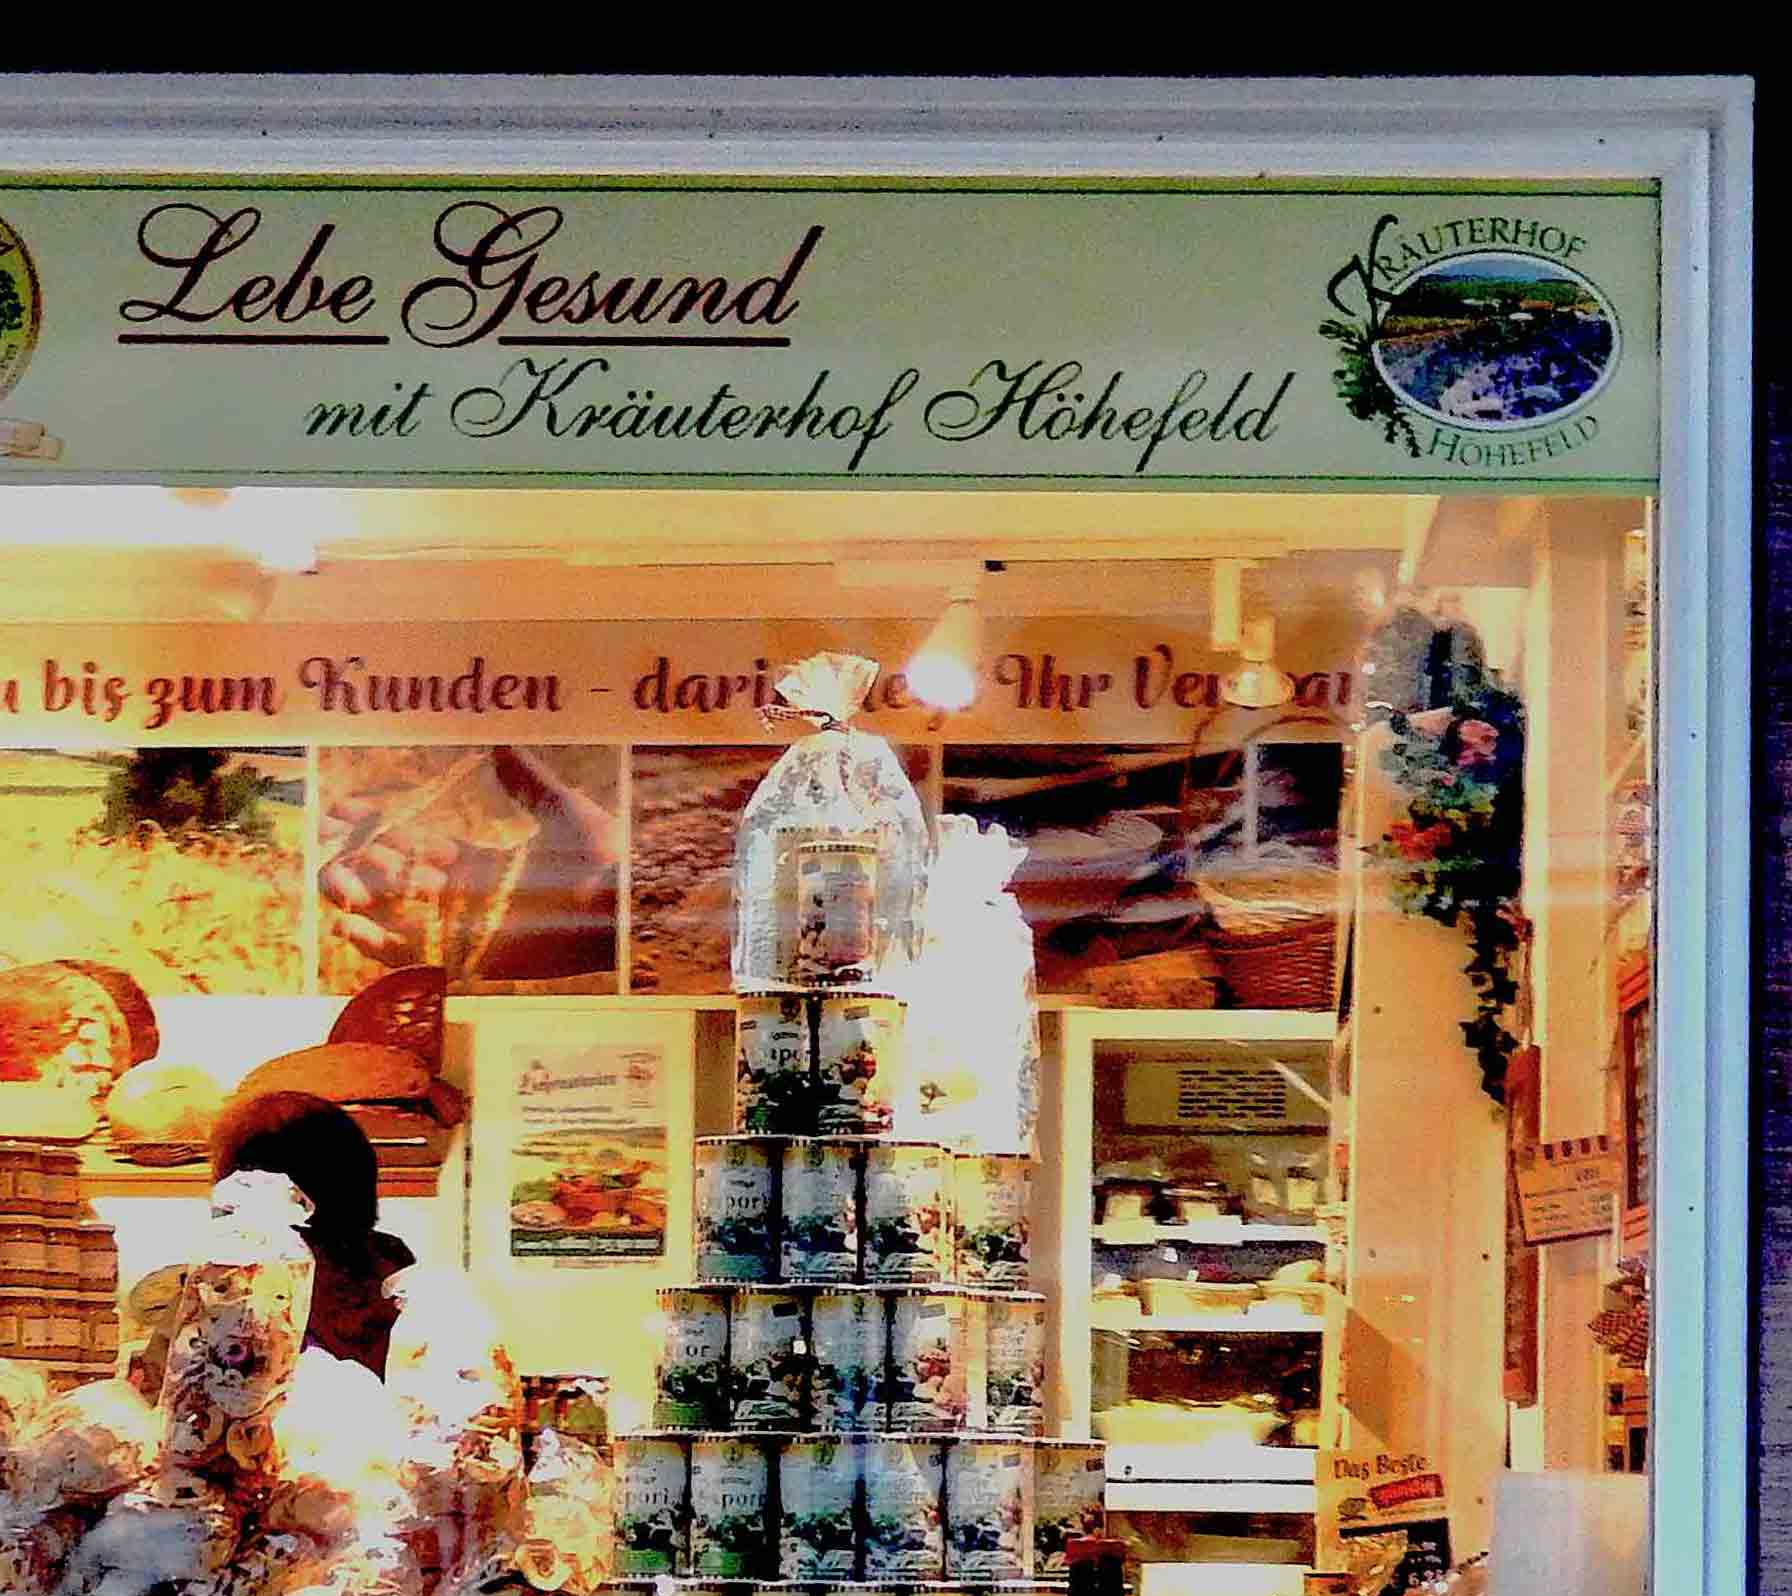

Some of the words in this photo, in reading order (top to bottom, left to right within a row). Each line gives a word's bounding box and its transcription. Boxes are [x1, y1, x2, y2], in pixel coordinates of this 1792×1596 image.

[119, 202, 378, 324] Lebe
[401, 200, 825, 348] Gesund
[305, 382, 433, 439] mit
[450, 357, 920, 471] Kräuterhof
[923, 360, 1297, 473] Höhefeld
[41, 659, 127, 721] bis
[144, 671, 281, 730] zum
[299, 656, 564, 715] Kunden
[632, 656, 770, 713] dari
[993, 652, 1114, 712] Ihr
